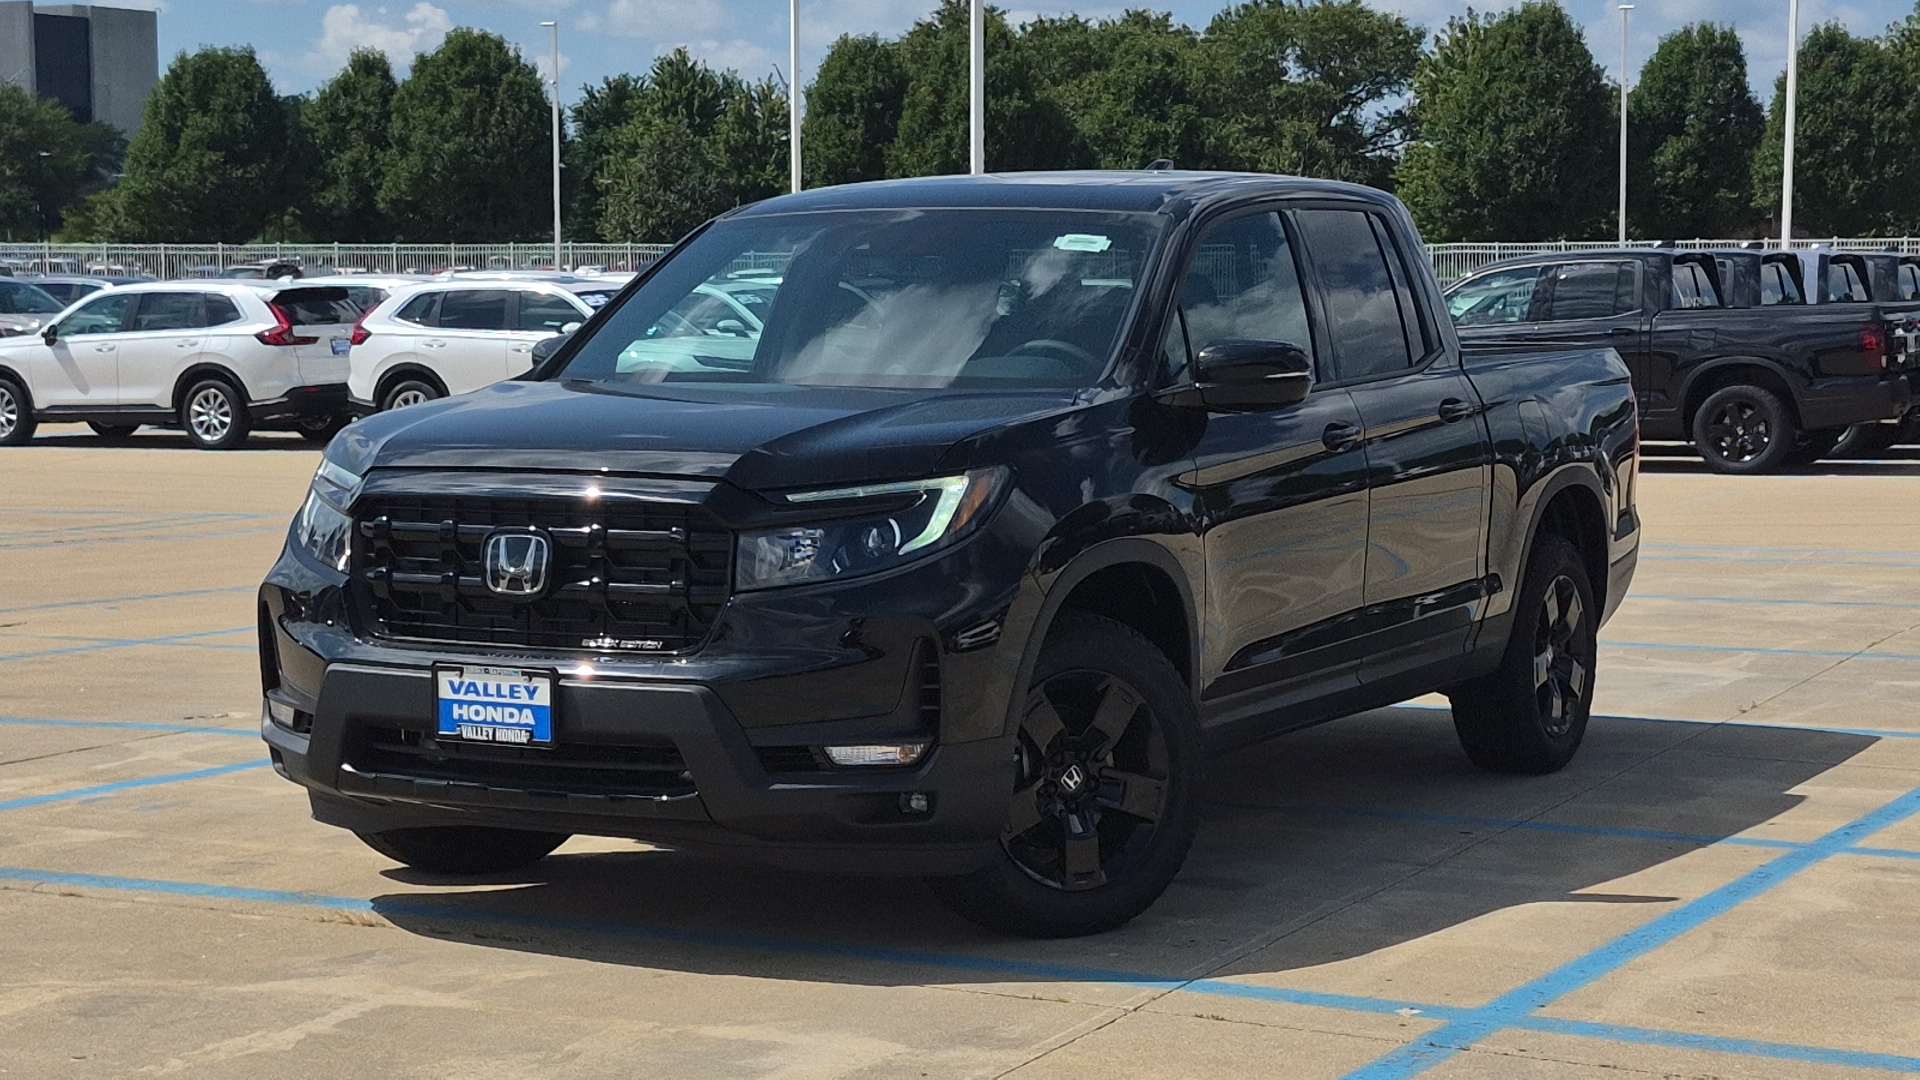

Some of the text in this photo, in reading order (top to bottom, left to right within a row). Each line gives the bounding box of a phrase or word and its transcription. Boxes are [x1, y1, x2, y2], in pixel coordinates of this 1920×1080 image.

[448, 680, 540, 700] VALLEY
[452, 703, 536, 725] HONDA
[461, 725, 528, 744] VALLEY HONDA
